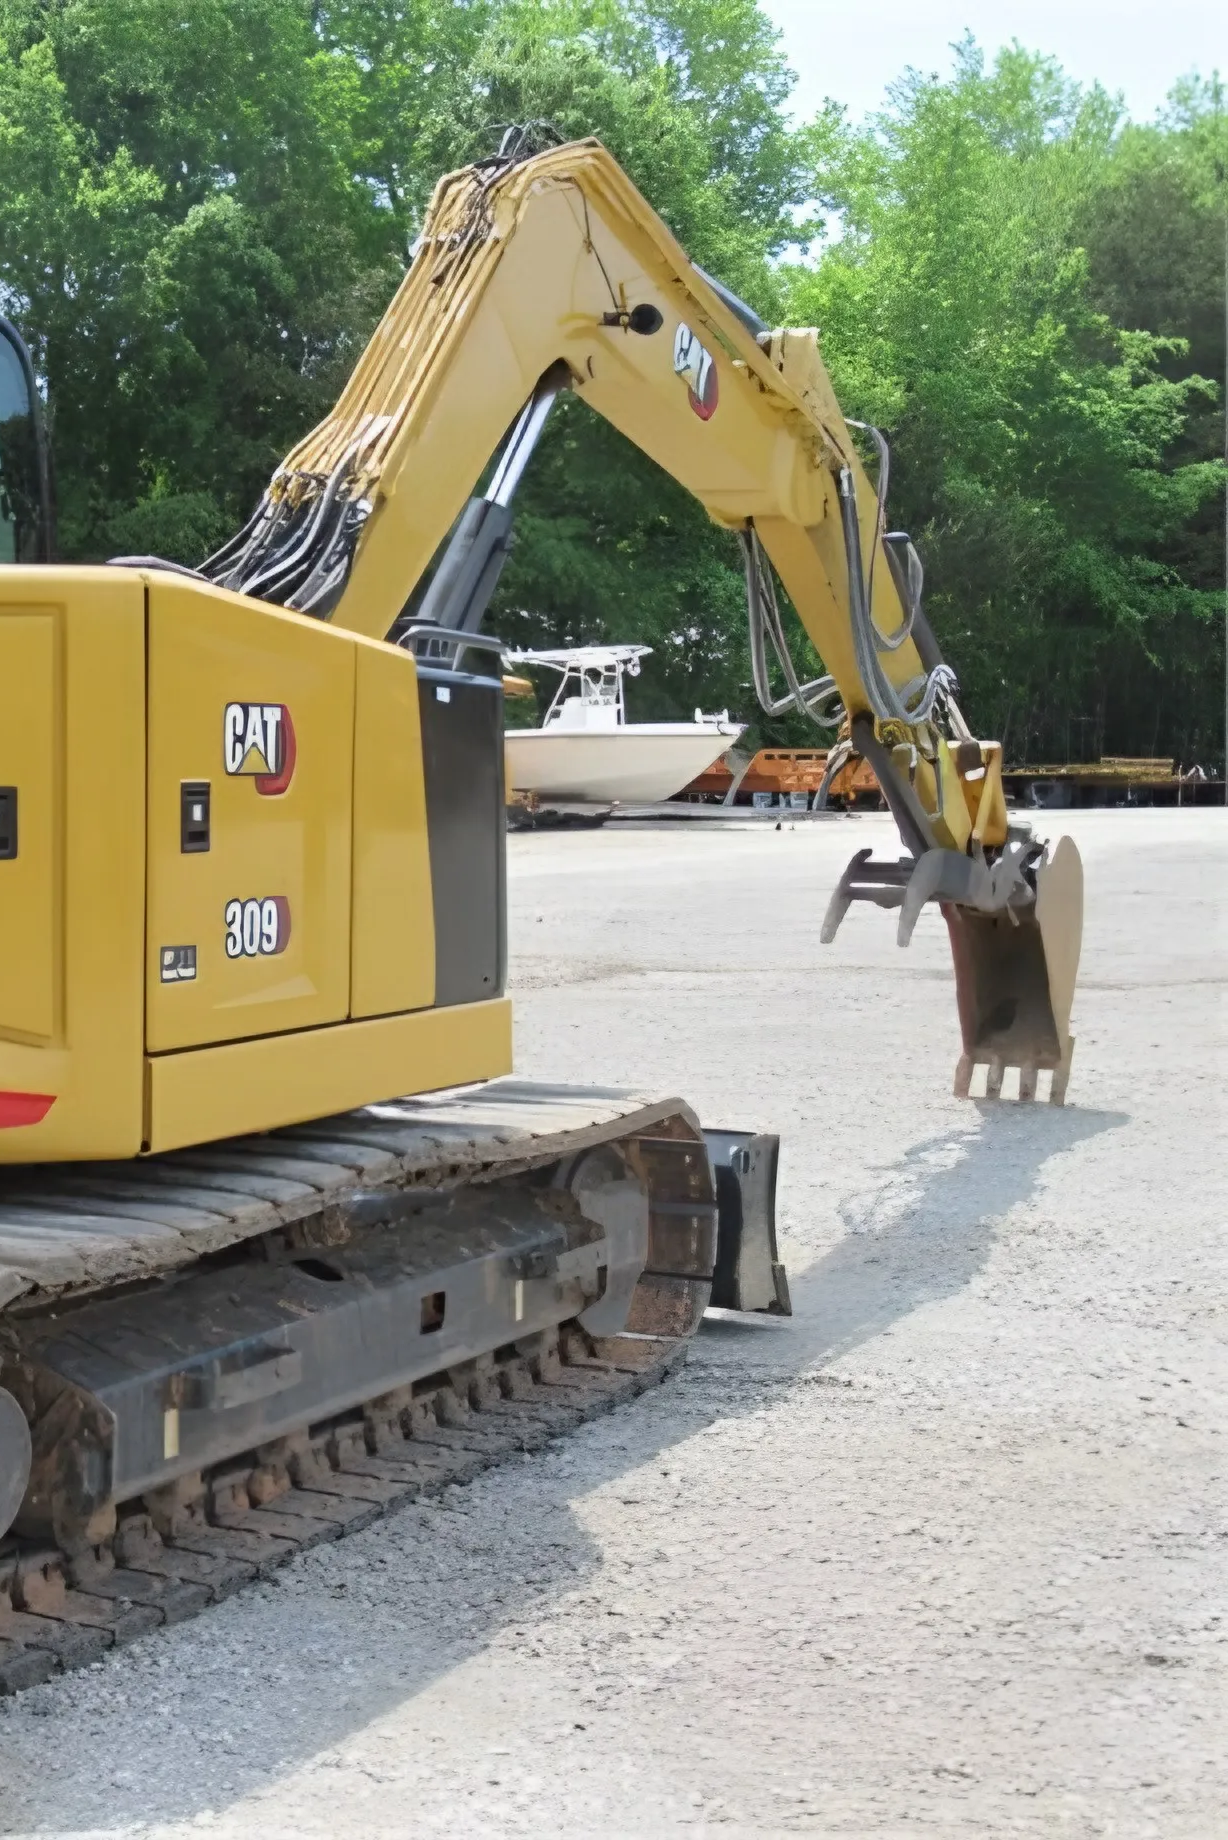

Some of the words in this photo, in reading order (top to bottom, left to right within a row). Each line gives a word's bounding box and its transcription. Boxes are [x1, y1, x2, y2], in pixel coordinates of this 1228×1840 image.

[674, 322, 712, 402] CAT
[225, 703, 282, 774] CAT
[226, 899, 278, 956] 309
